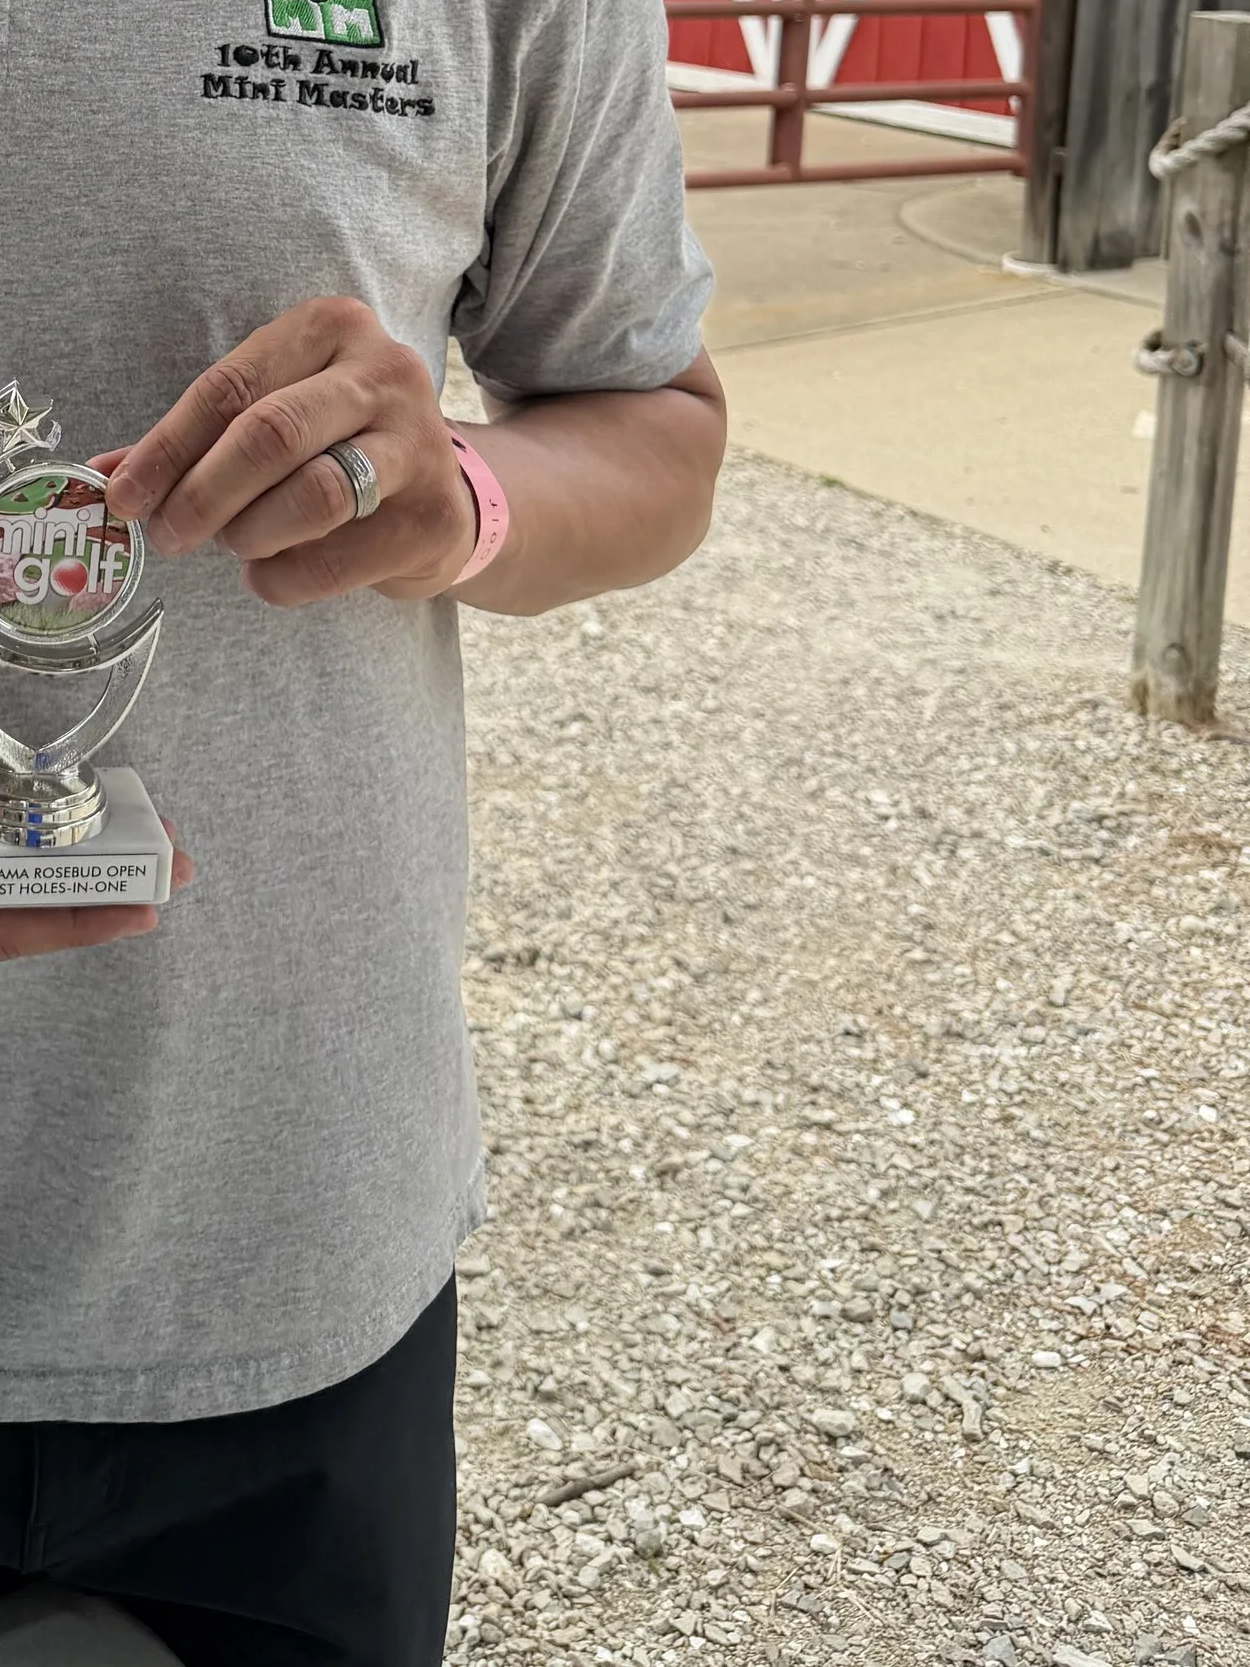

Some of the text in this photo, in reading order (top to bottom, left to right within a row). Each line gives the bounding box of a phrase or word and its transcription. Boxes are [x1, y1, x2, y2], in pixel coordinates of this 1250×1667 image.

[214, 43, 419, 84] 10th Annual
[200, 73, 436, 117] Mini Masters
[13, 543, 125, 606] golf
[19, 880, 128, 895] HOLES-IN-ONE
[33, 866, 103, 879] ROSEBUD
[106, 864, 147, 878] OPEN
